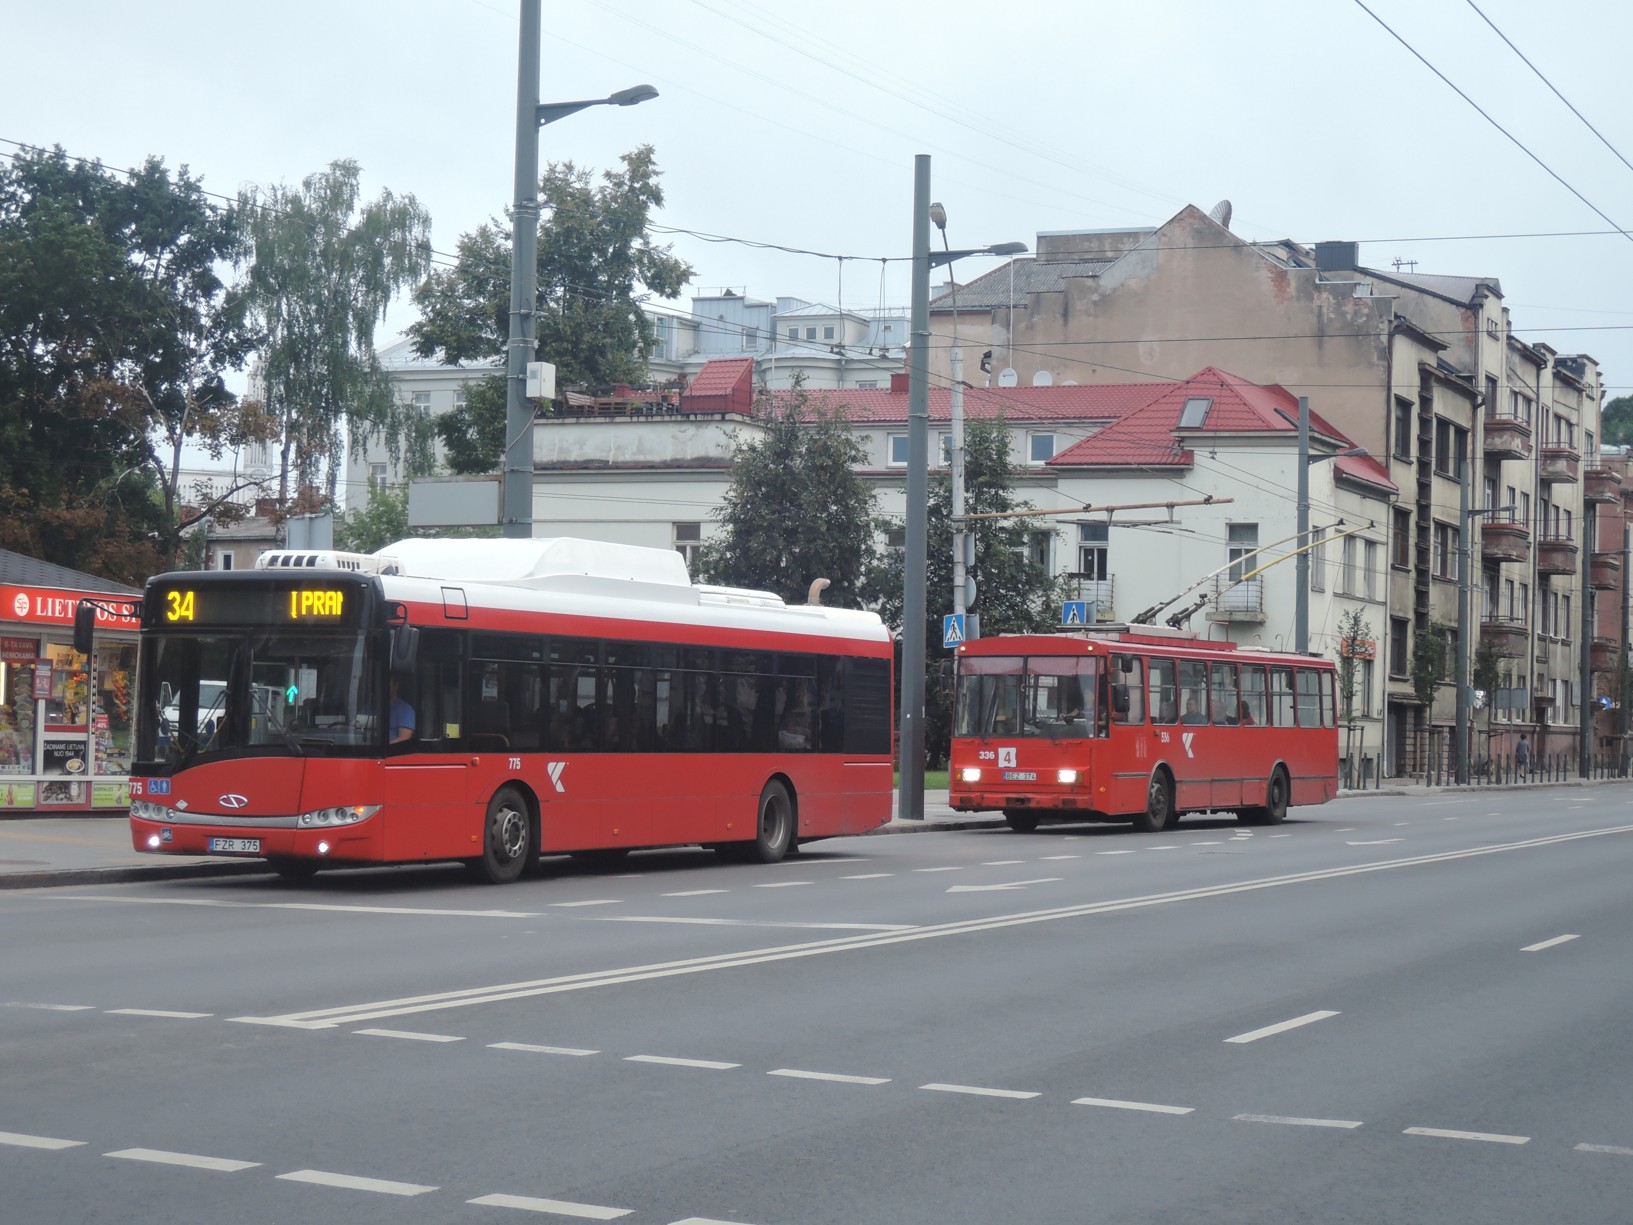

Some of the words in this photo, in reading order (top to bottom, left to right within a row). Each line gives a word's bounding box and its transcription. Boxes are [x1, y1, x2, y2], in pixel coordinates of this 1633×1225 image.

[36, 597, 117, 621] LIETOS
[167, 591, 194, 621] 34
[1160, 731, 1170, 743] 336
[979, 751, 995, 759] 336
[1003, 751, 1012, 765] 4
[508, 757, 521, 770] 775
[129, 782, 142, 795] 775
[214, 839, 235, 850] FZR
[240, 840, 258, 851] 375
